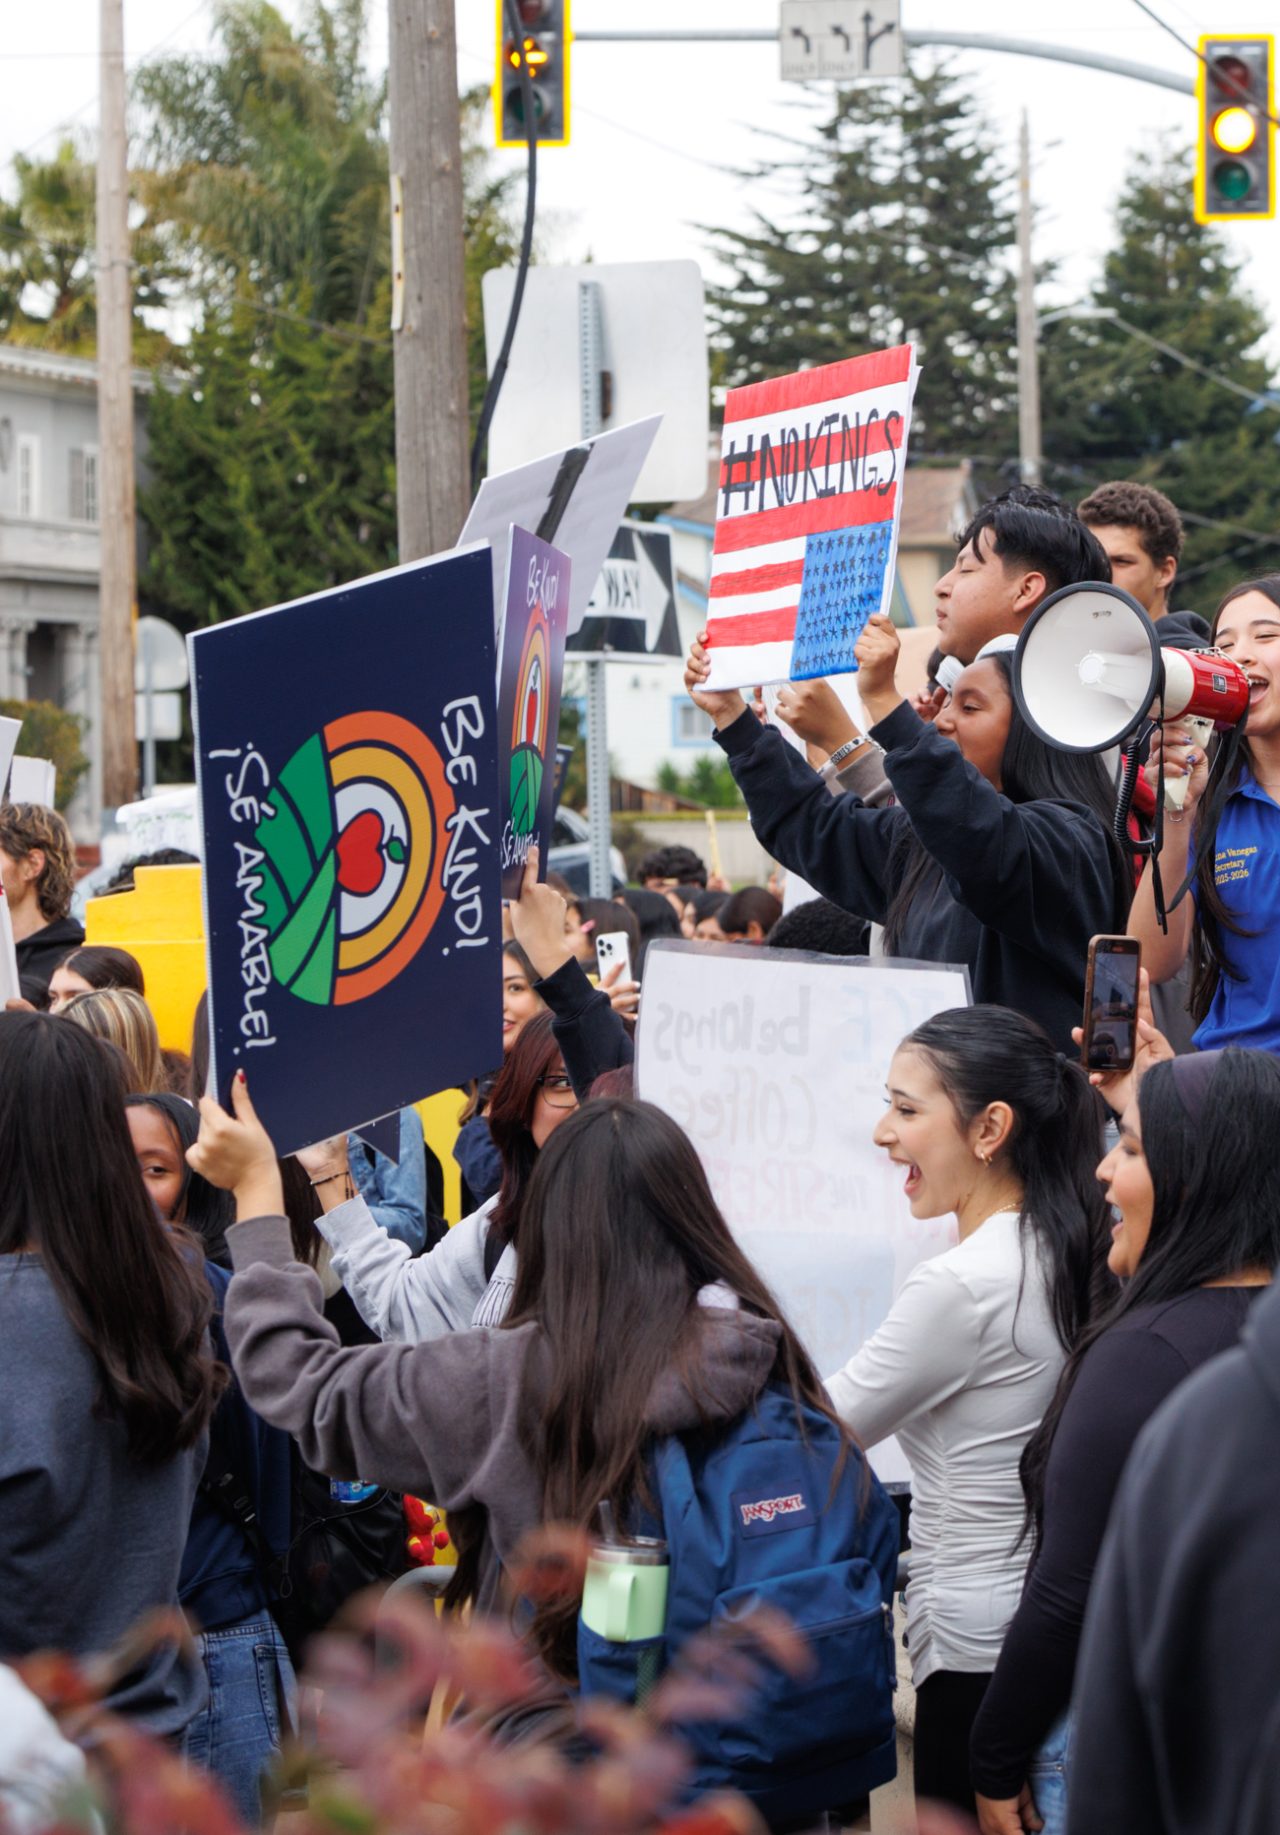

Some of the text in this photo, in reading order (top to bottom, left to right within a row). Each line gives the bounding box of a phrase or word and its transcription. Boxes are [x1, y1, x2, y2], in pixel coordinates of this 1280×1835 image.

[600, 566, 641, 609] WAY
[208, 742, 277, 1056] ¡SÉ AMABLE!
[441, 695, 491, 956] BE KIND!
[740, 1493, 806, 1526] JANSPORT
